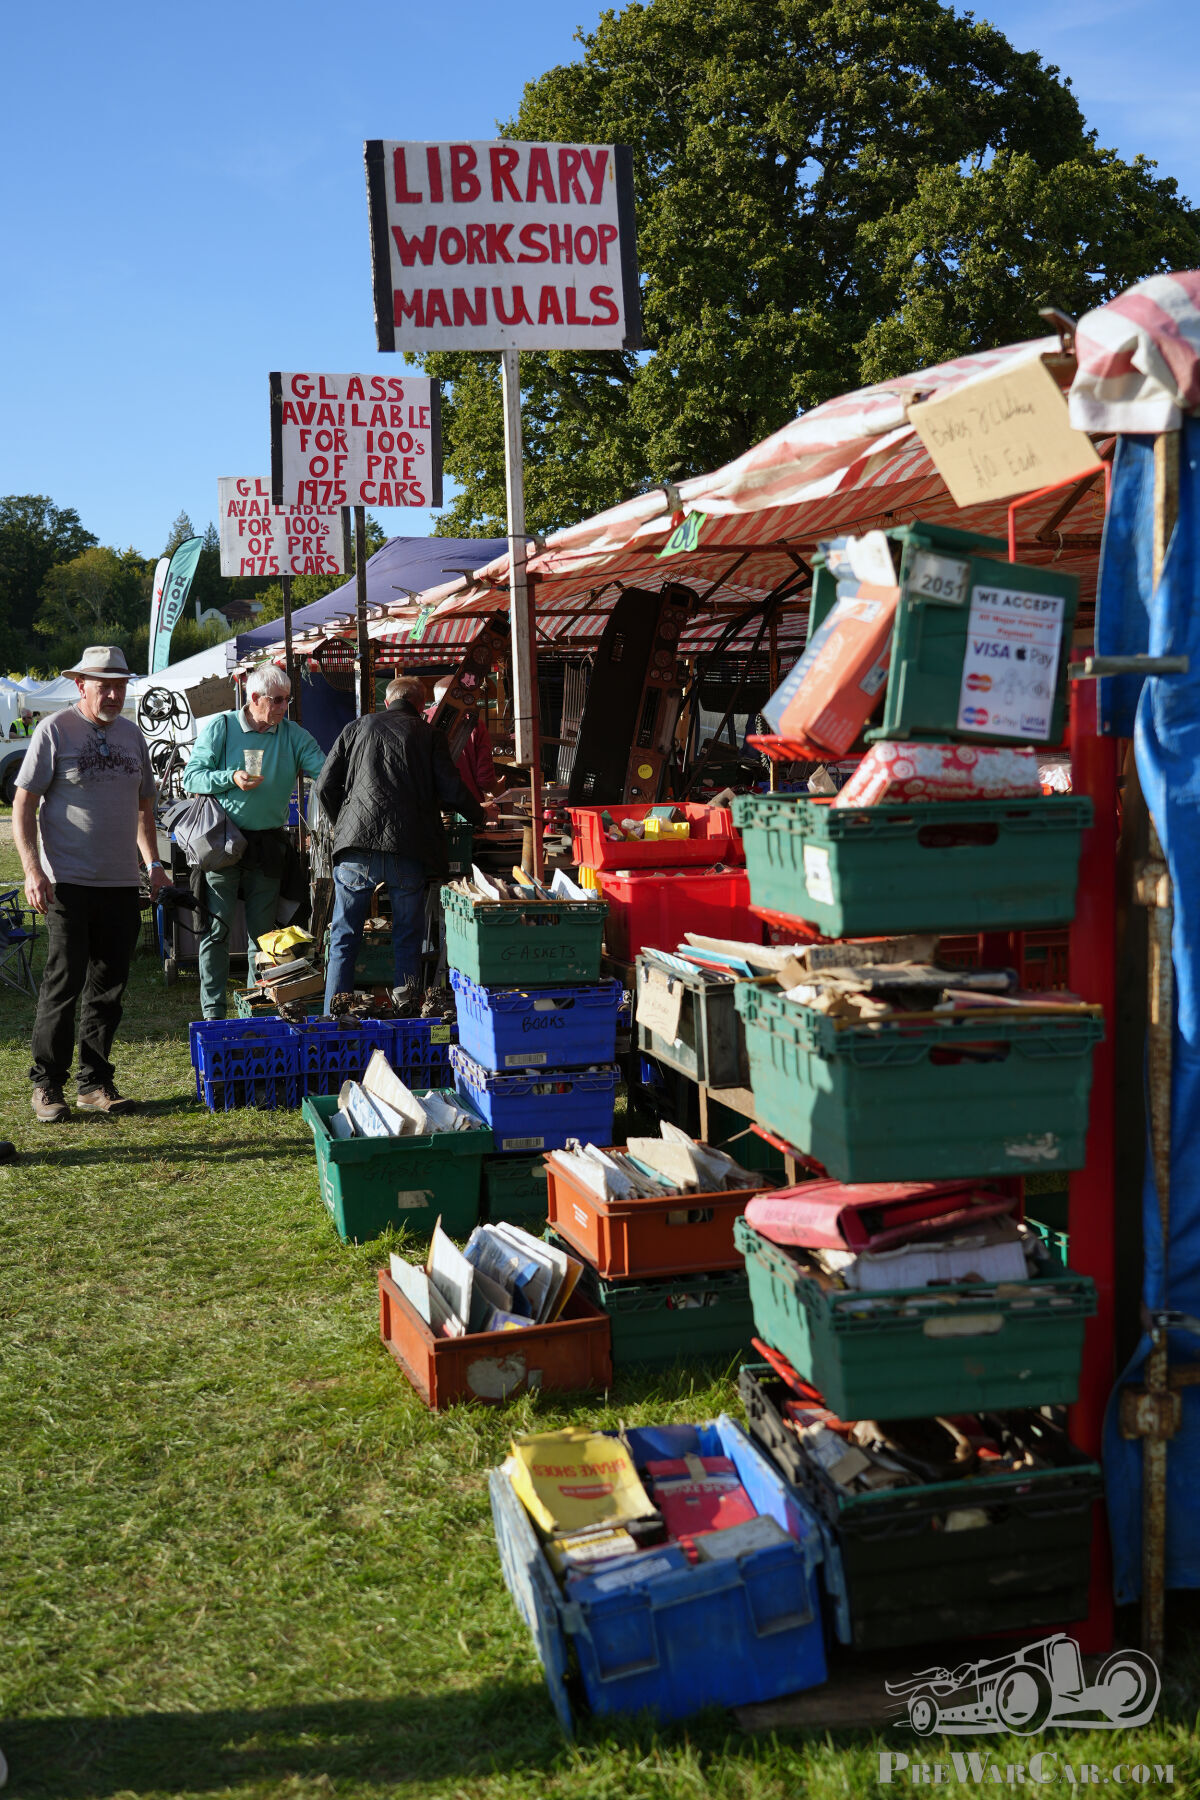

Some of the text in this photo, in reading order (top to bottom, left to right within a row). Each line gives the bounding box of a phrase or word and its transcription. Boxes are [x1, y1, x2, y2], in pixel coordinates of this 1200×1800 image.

[393, 145, 609, 205] LIBRARY
[391, 223, 618, 267] WORKSHOP
[393, 285, 620, 328] MANUALS
[291, 374, 404, 402] GLASS
[281, 401, 431, 429] AVAILABLE
[299, 428, 426, 455] FOR 100's
[308, 454, 417, 480] OF PRE
[297, 479, 426, 507] 1975 CARS
[227, 499, 337, 517] AVAILABLE
[238, 516, 330, 537] FOR 100's
[248, 536, 328, 556] OF PRE
[240, 555, 340, 577] 1975 CARS
[921, 573, 964, 600] 2051
[159, 572, 188, 633] TUDOR
[977, 591, 1059, 613] WE ACCEPT
[973, 640, 1011, 659] VISA
[501, 945, 576, 961] GASKETS
[522, 1015, 566, 1033] BOOKS
[532, 1457, 627, 1478] BRAKE SHOES
